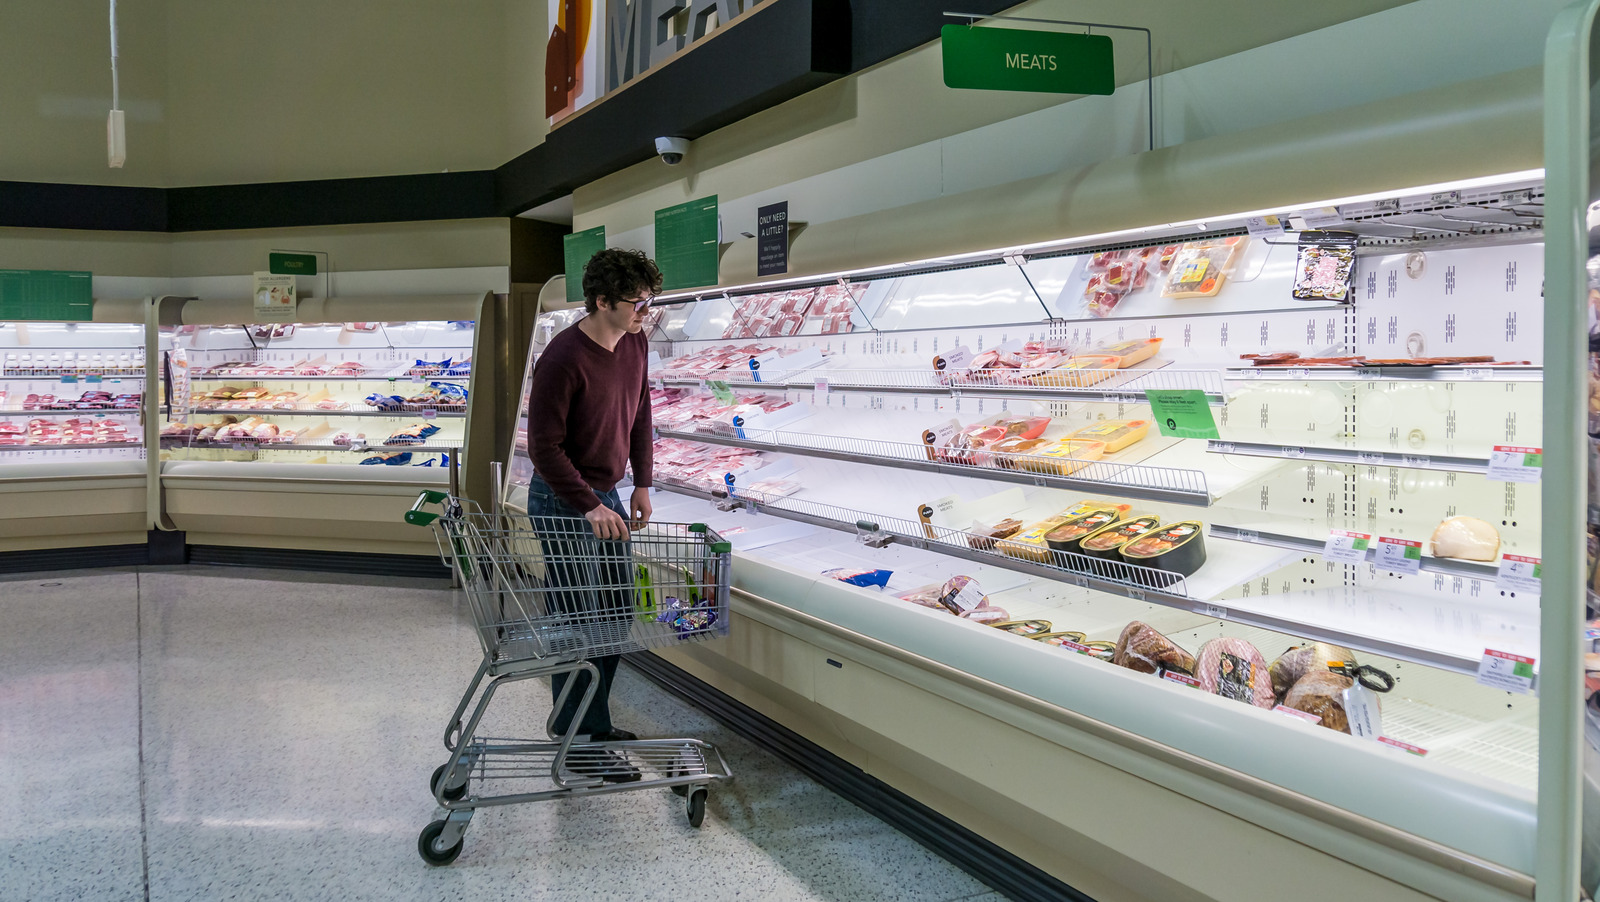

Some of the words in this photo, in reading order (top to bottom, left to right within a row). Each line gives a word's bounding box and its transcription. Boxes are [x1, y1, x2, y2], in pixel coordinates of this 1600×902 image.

[604, 0, 753, 92] MEA
[1005, 52, 1058, 71] MEATS
[759, 214, 771, 225] ONLY
[773, 211, 786, 222] NEED
[766, 225, 783, 236] LITTLE?
[949, 351, 964, 360] SMOKED
[952, 356, 964, 364] MEATS
[937, 500, 954, 508] SMOKED
[1385, 544, 1391, 554] 5
